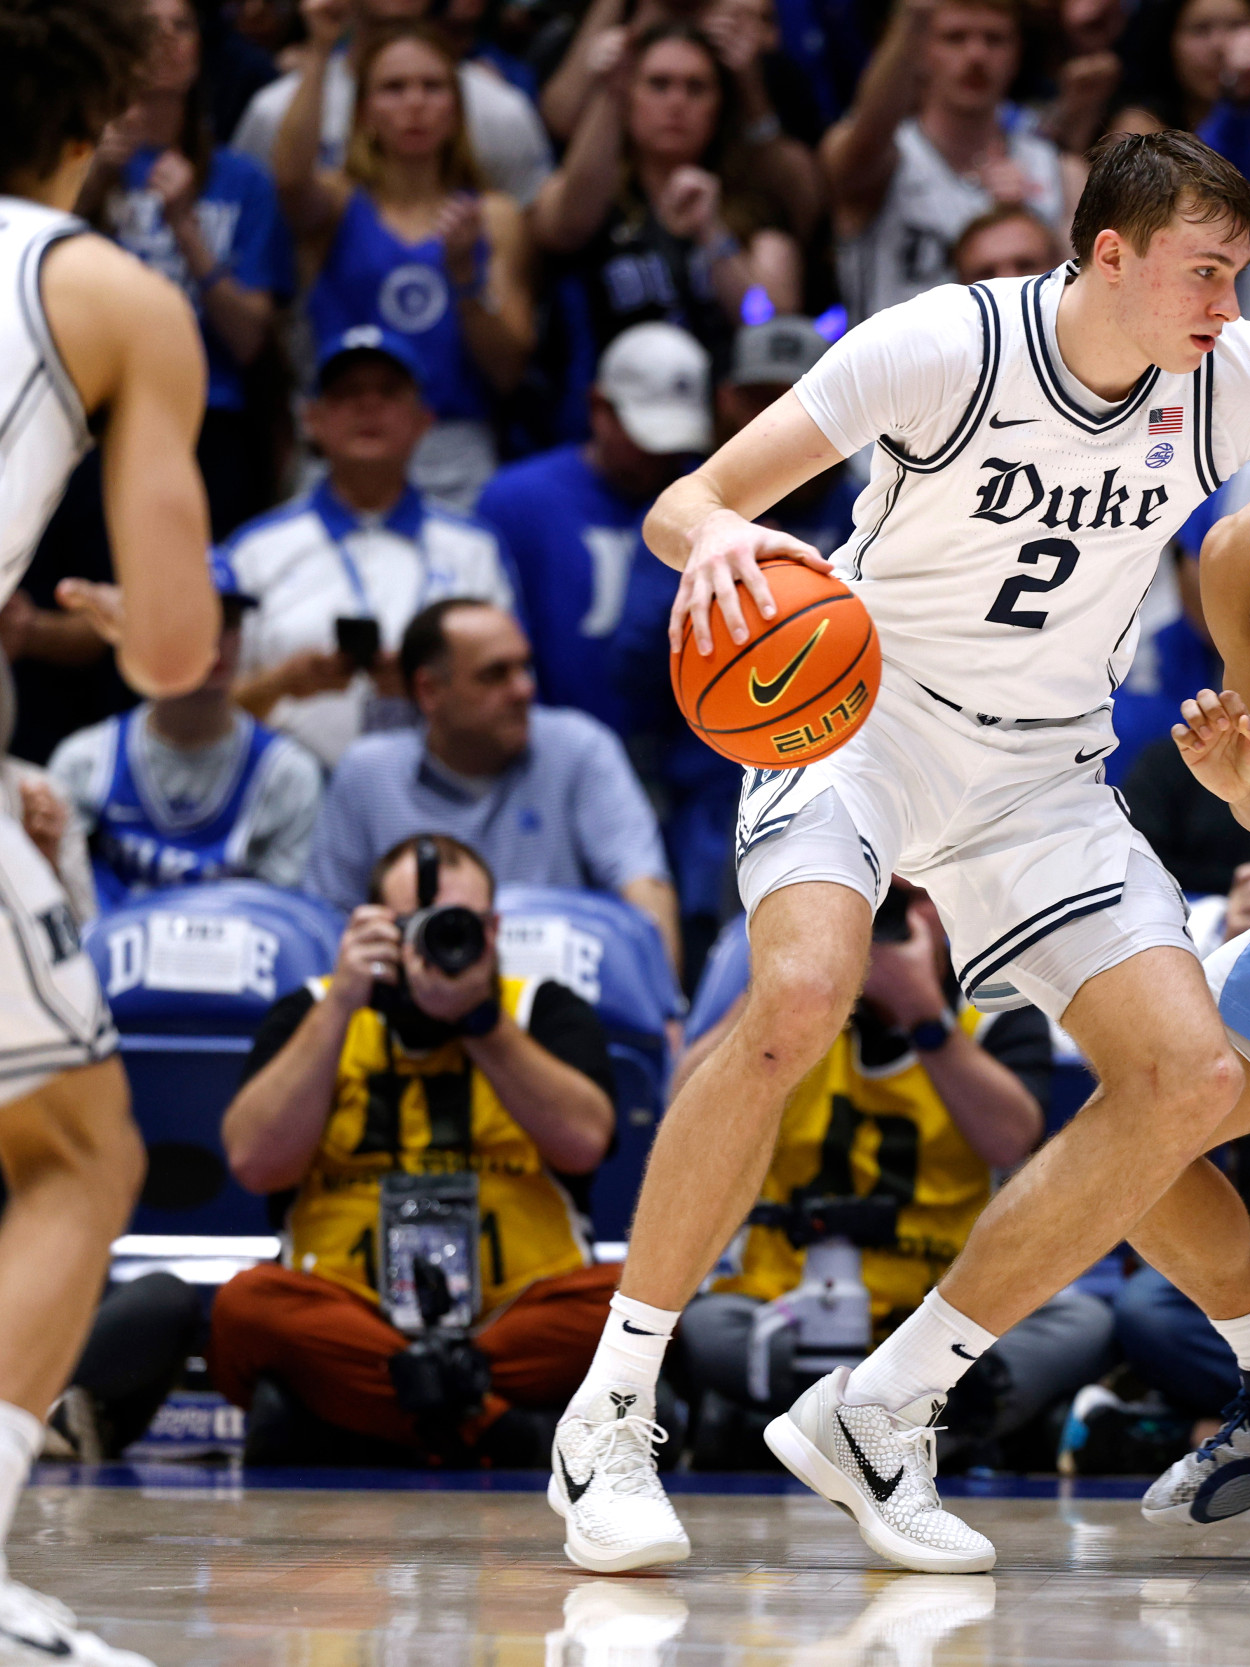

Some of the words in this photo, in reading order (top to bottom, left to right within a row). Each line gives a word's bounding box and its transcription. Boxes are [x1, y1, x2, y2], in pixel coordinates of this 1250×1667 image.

[969, 457, 1169, 532] Duke
[984, 538, 1081, 630] 2
[772, 679, 869, 754] ELITE
